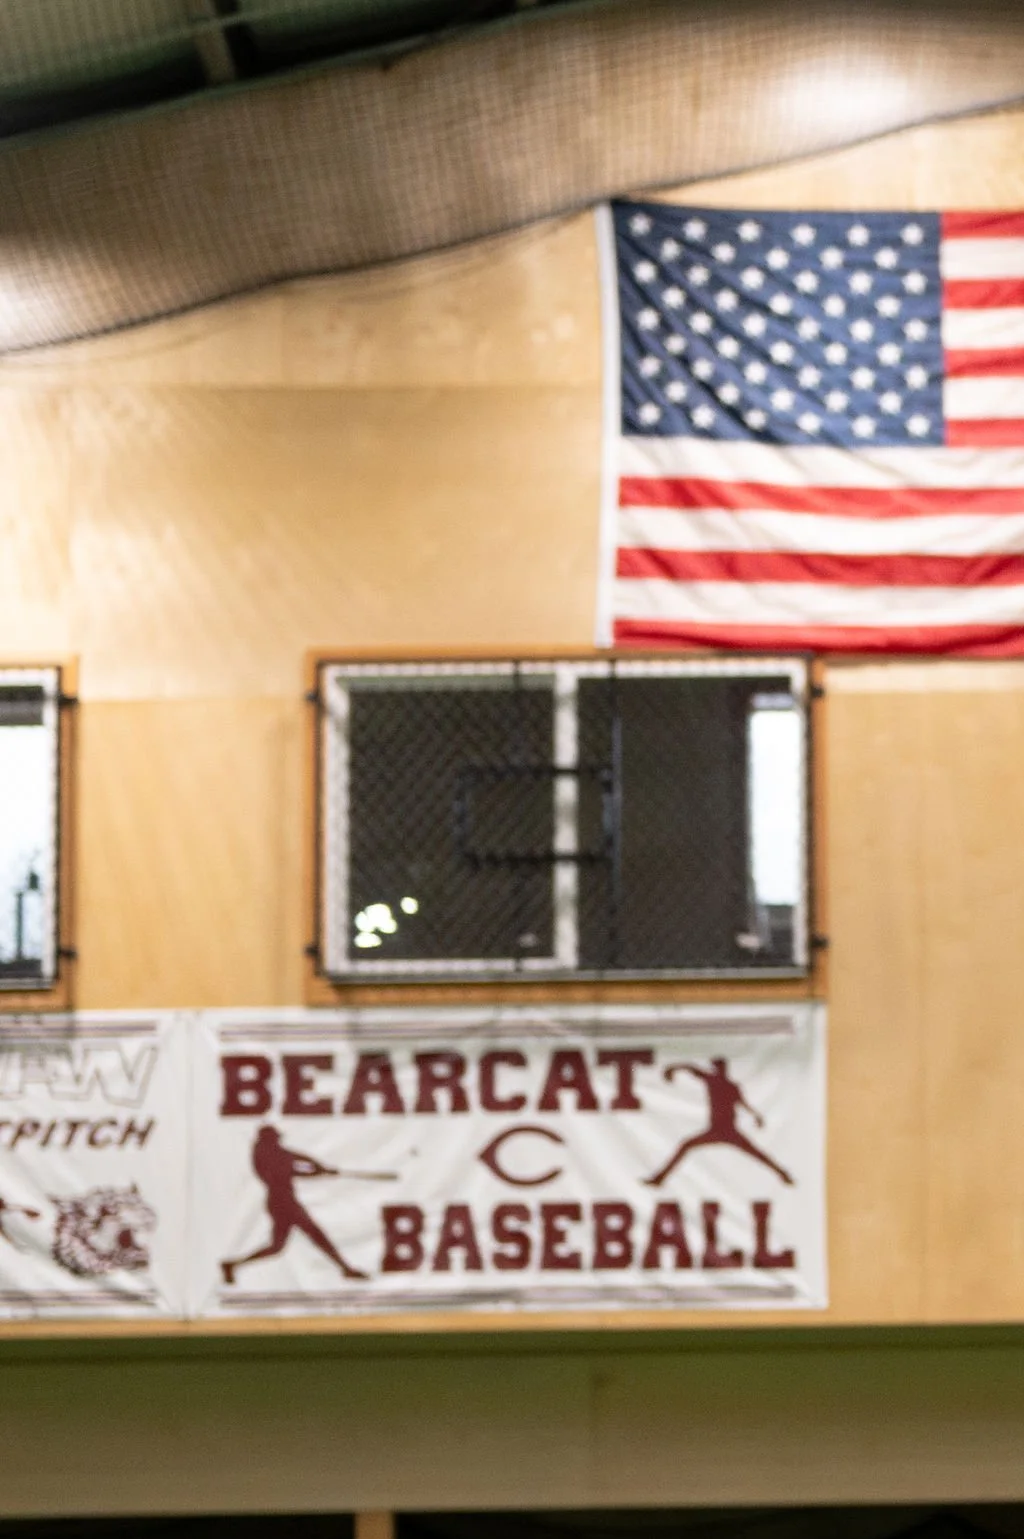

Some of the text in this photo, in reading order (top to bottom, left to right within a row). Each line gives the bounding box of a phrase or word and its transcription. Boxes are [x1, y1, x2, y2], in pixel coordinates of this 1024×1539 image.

[219, 1048, 654, 1117] BEARCAT
[478, 1125, 566, 1187] C
[381, 1201, 796, 1273] BASEBALL
